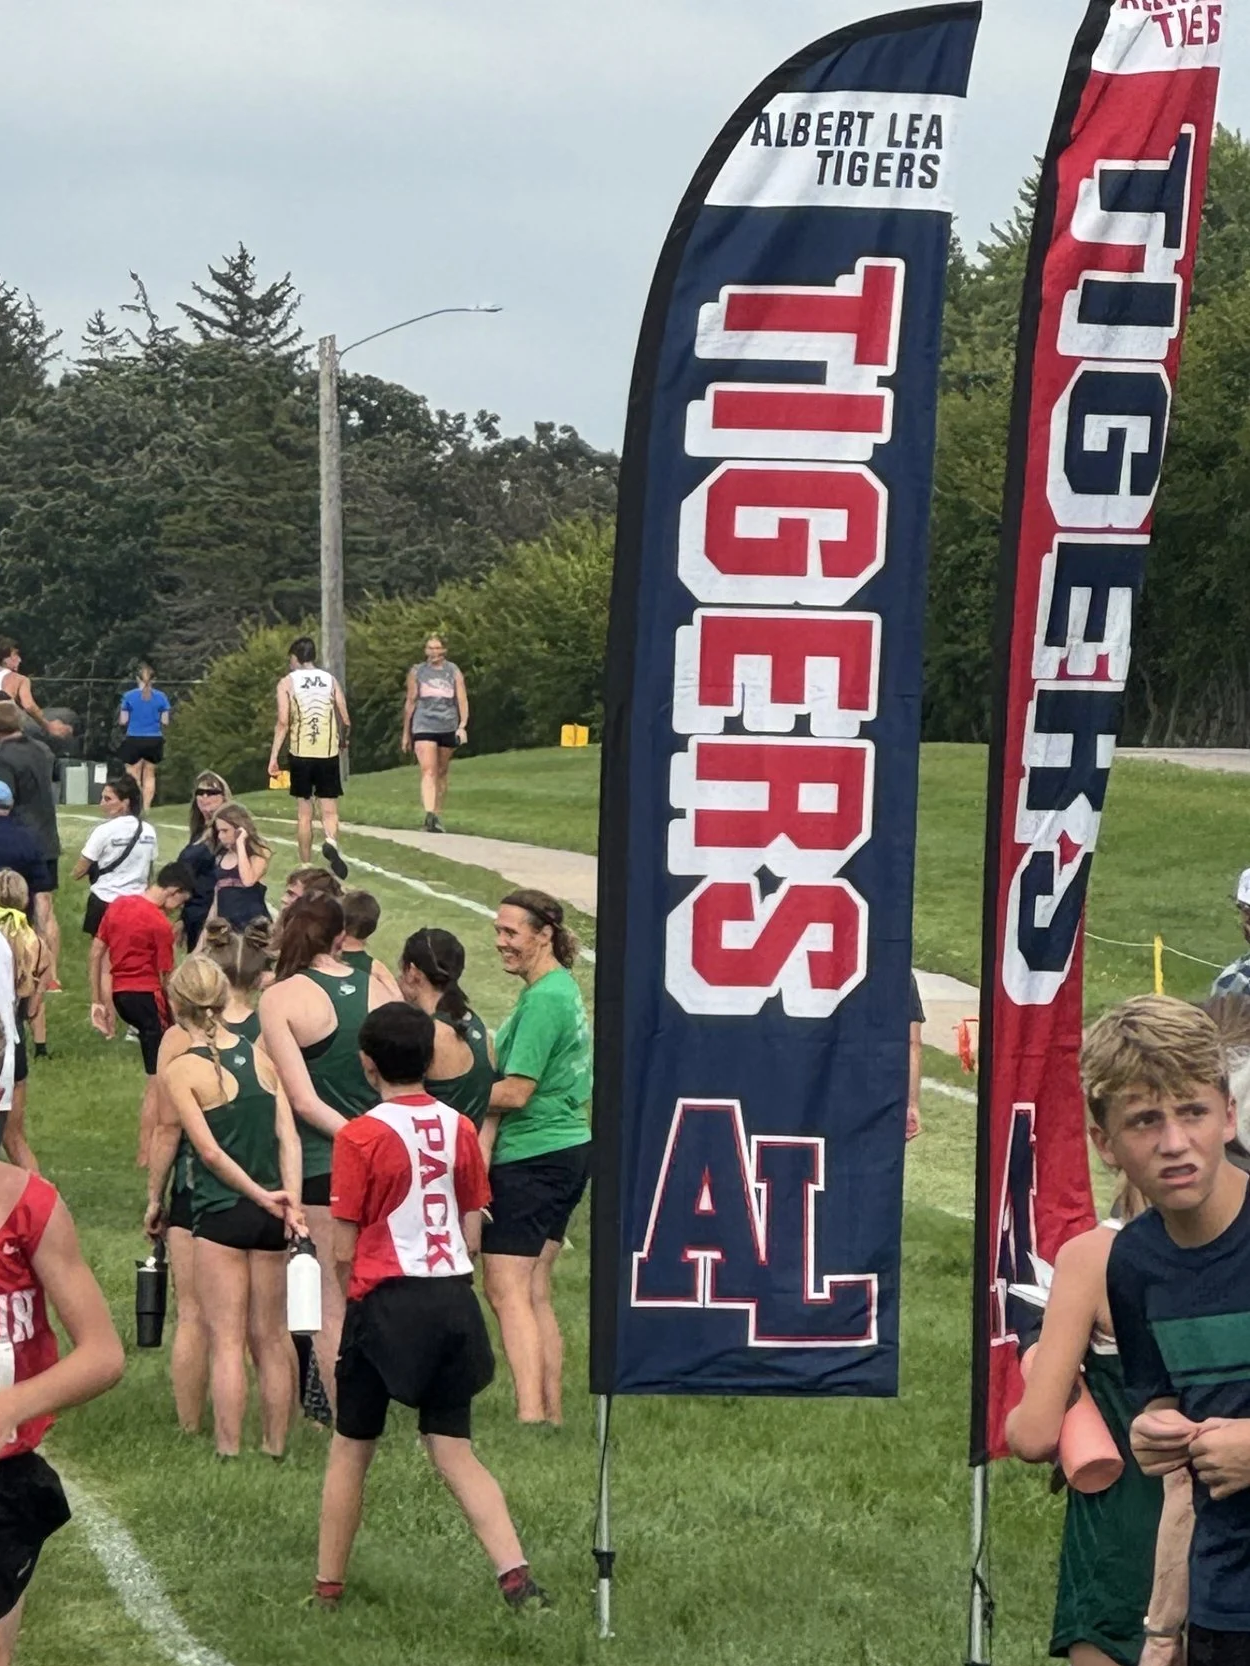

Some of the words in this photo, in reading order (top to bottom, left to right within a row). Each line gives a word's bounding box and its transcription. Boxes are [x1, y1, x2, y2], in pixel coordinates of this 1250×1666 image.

[750, 110, 875, 147] ALBERT
[886, 112, 943, 150] LEA
[817, 150, 940, 189] TIGERS
[664, 257, 906, 1019] TIGERS
[411, 1114, 455, 1272] PACK
[631, 1098, 879, 1347] AL
